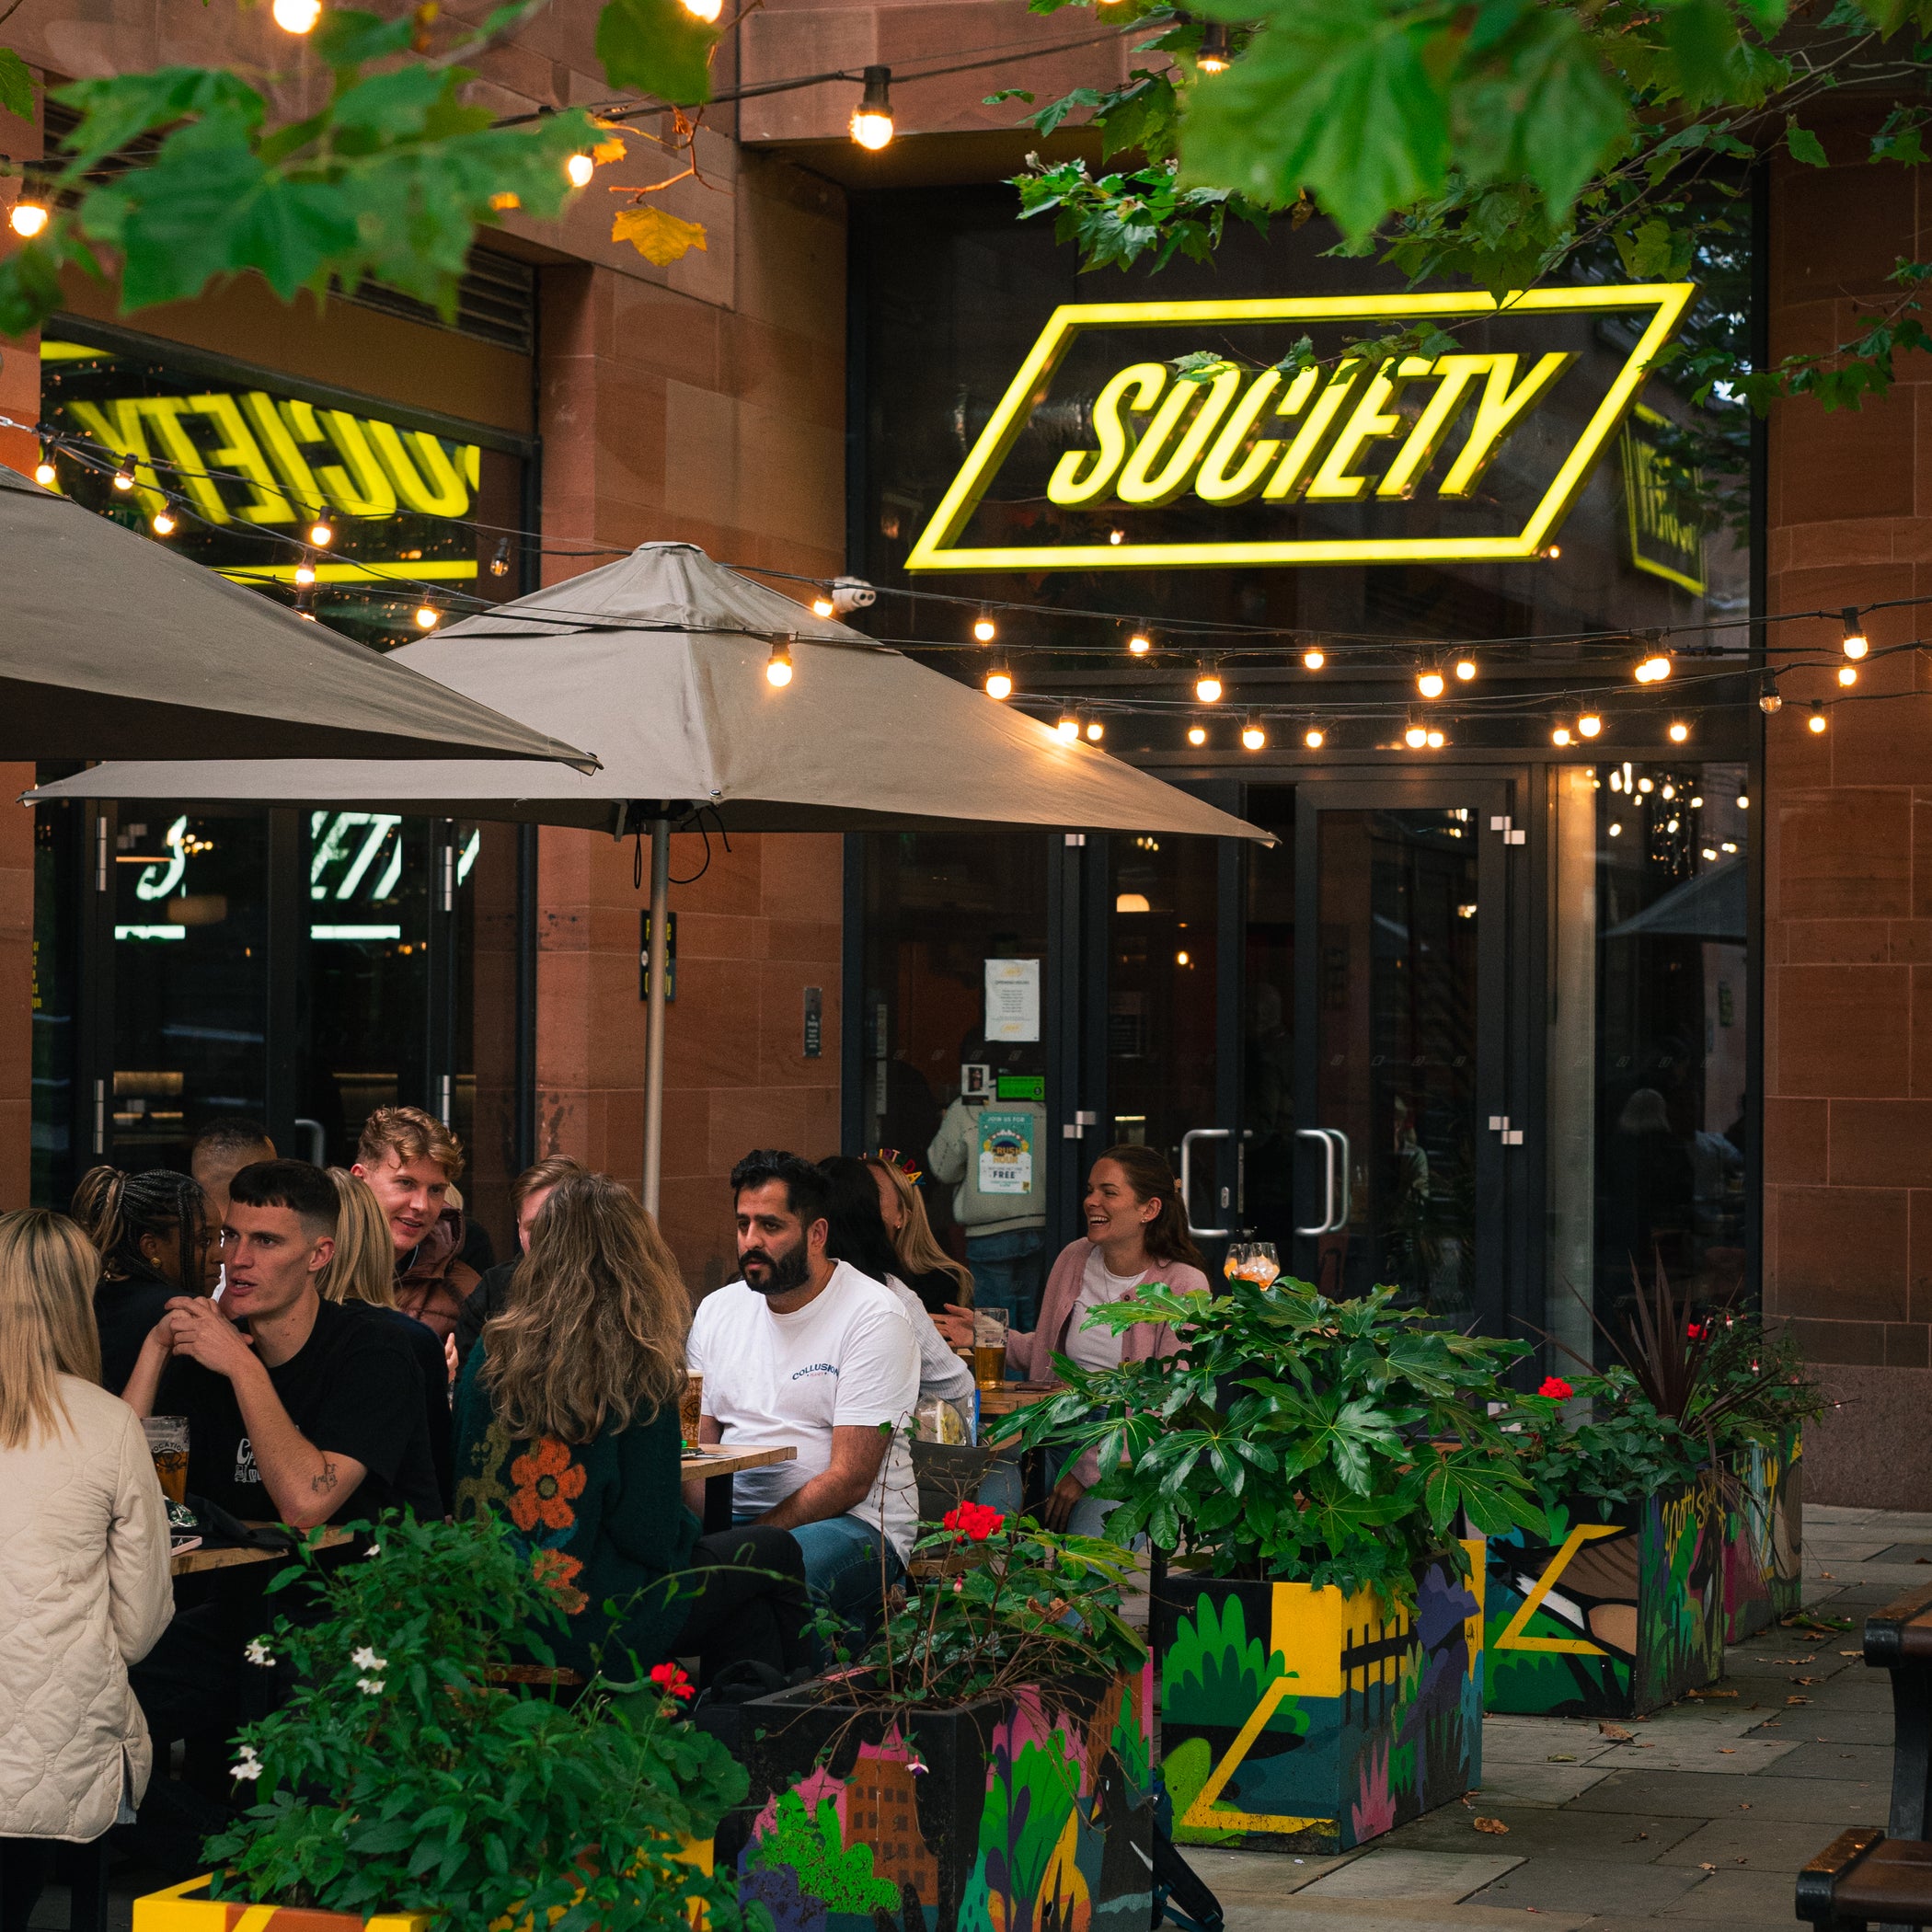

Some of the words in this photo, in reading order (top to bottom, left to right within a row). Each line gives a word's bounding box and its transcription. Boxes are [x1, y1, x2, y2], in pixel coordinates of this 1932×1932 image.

[1047, 351, 1579, 508] SOCIETY
[991, 1146, 1021, 1156] CRUSH
[993, 1170, 1016, 1179] FREE
[792, 1363, 839, 1380] COLLUSION
